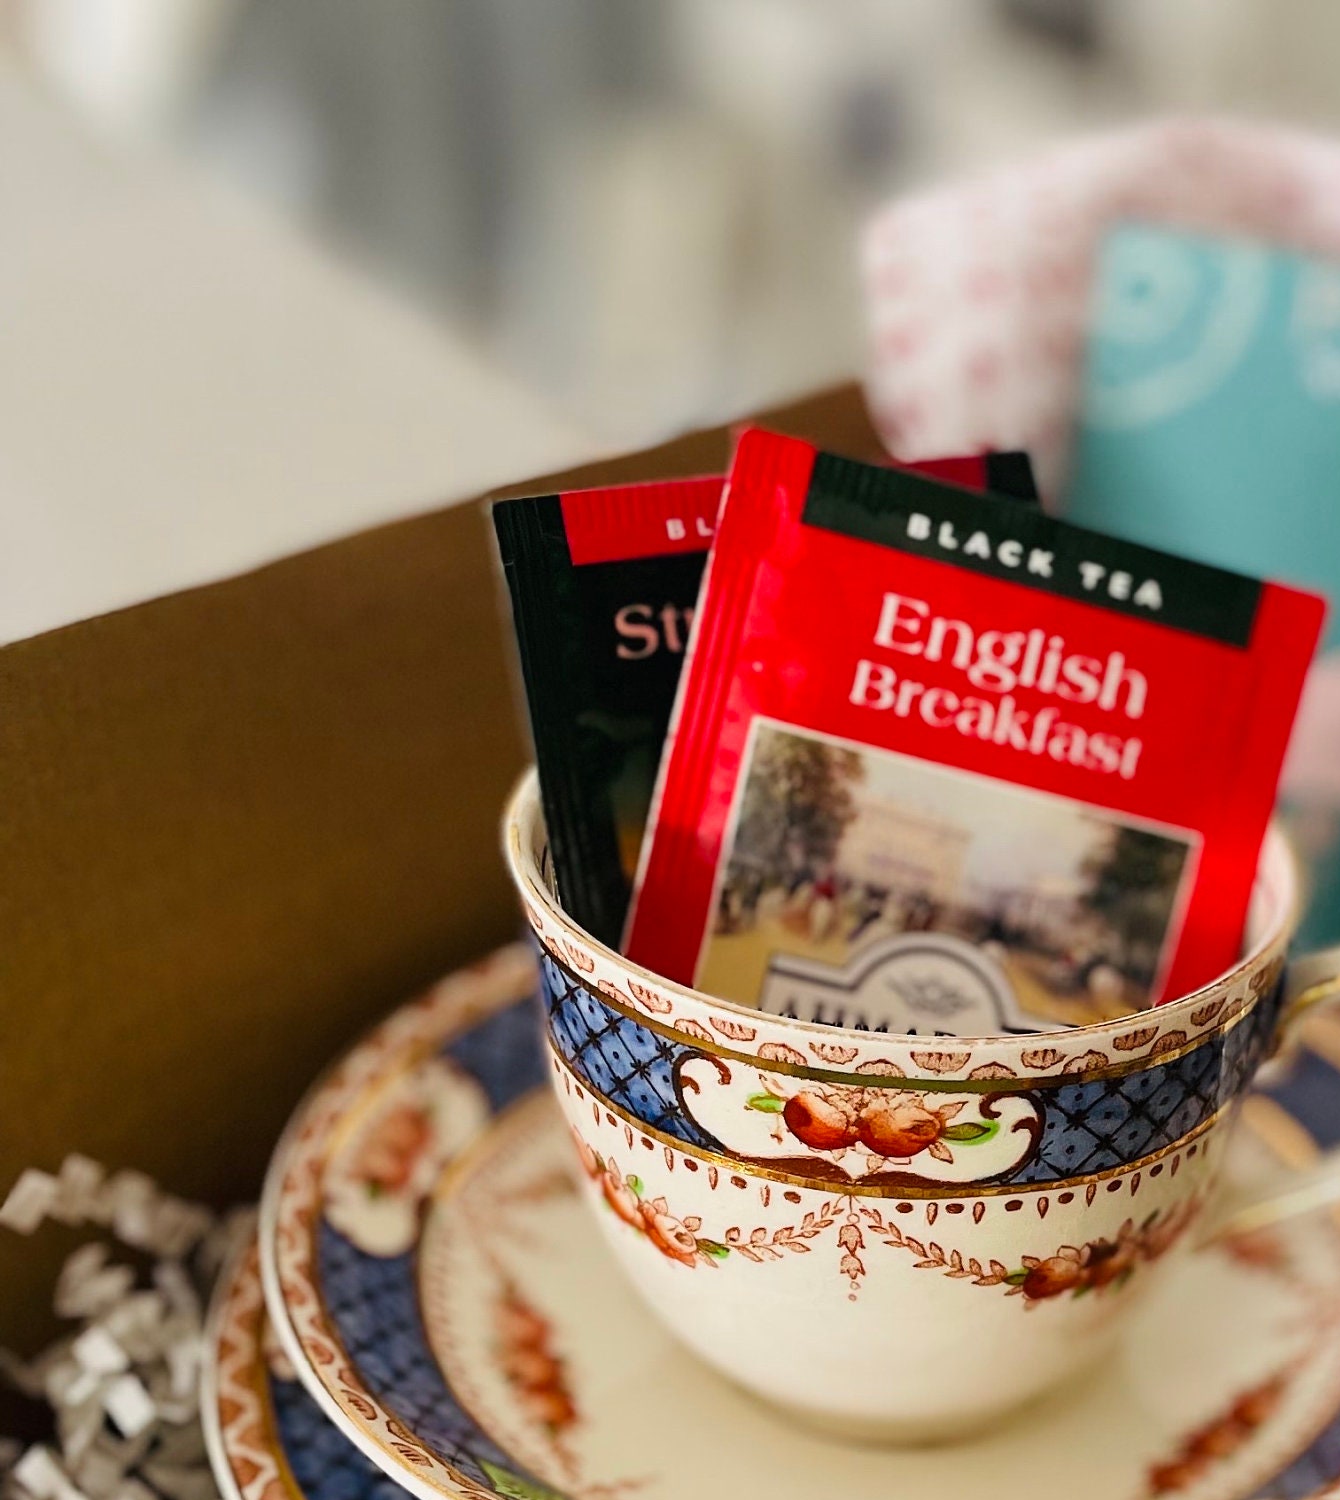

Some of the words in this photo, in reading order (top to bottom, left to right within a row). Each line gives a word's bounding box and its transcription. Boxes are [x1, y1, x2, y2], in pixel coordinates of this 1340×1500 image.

[906, 512, 1055, 578] BLACK
[1078, 560, 1164, 611] TEA
[873, 591, 1148, 719] English
[848, 658, 1143, 780] Breakfast
